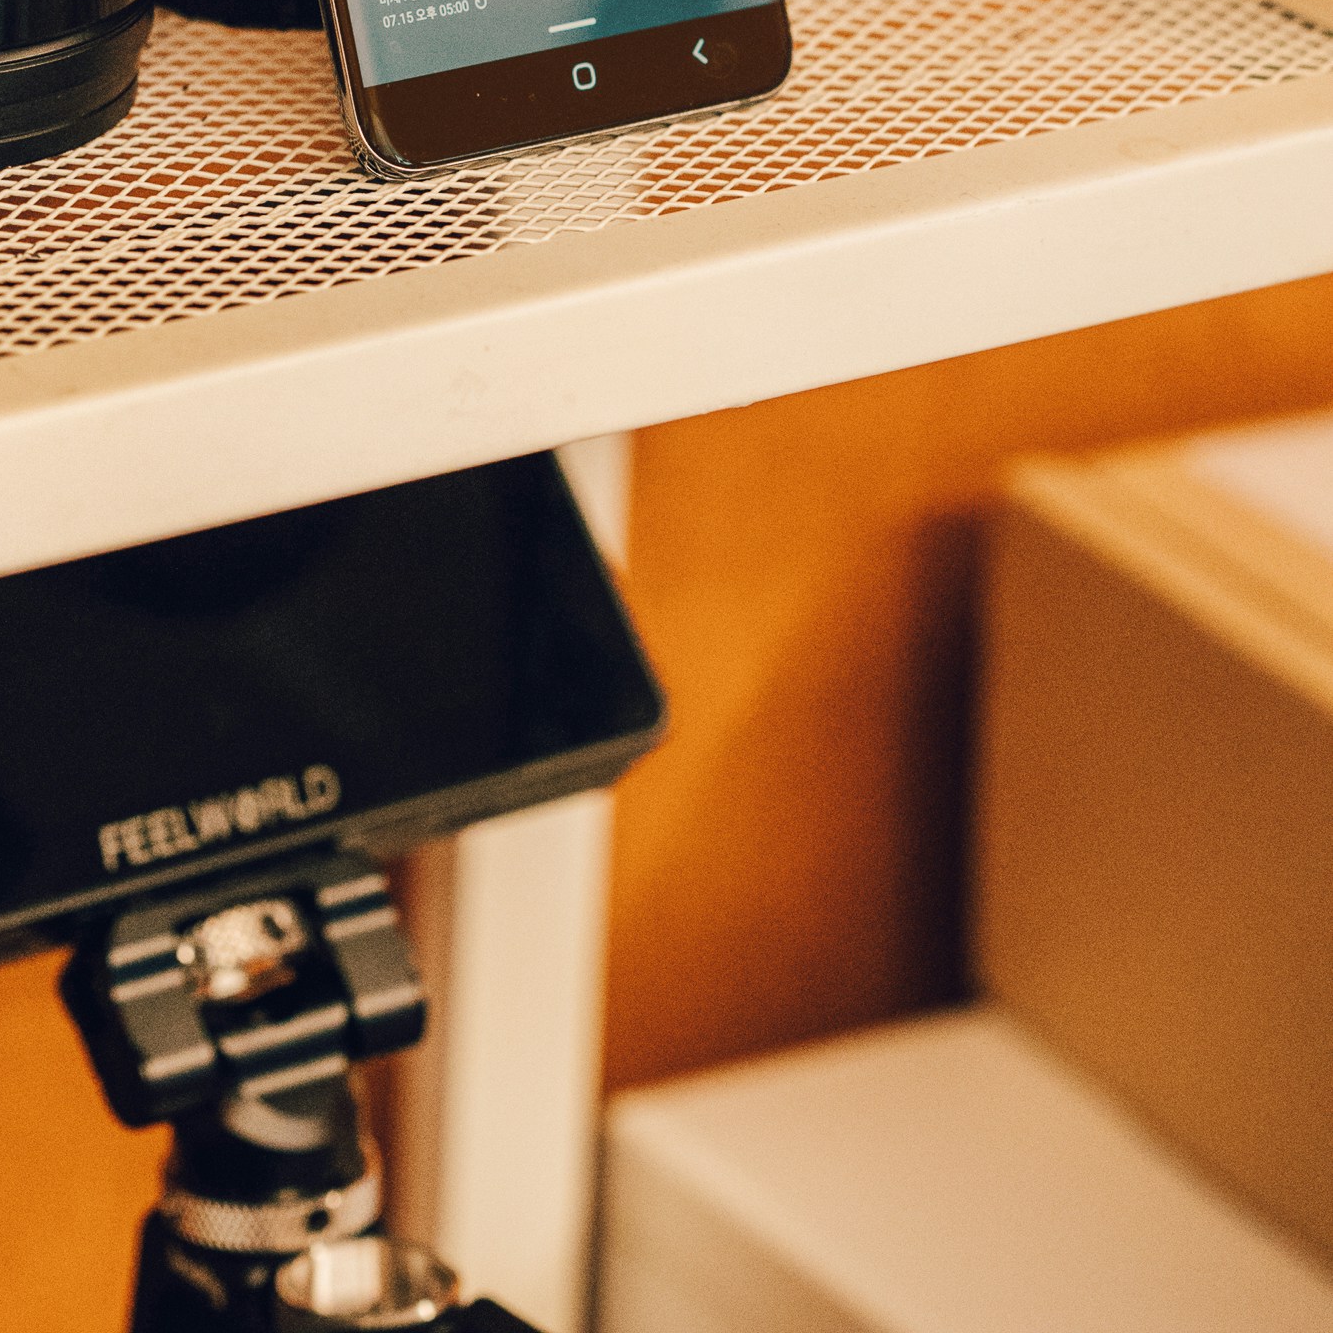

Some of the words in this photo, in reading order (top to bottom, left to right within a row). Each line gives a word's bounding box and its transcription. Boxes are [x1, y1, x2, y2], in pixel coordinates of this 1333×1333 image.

[382, 11, 415, 28] 07.15
[415, 6, 437, 21] 오후
[439, 0, 469, 16] 05:00
[98, 764, 342, 872] FEELWORLD
